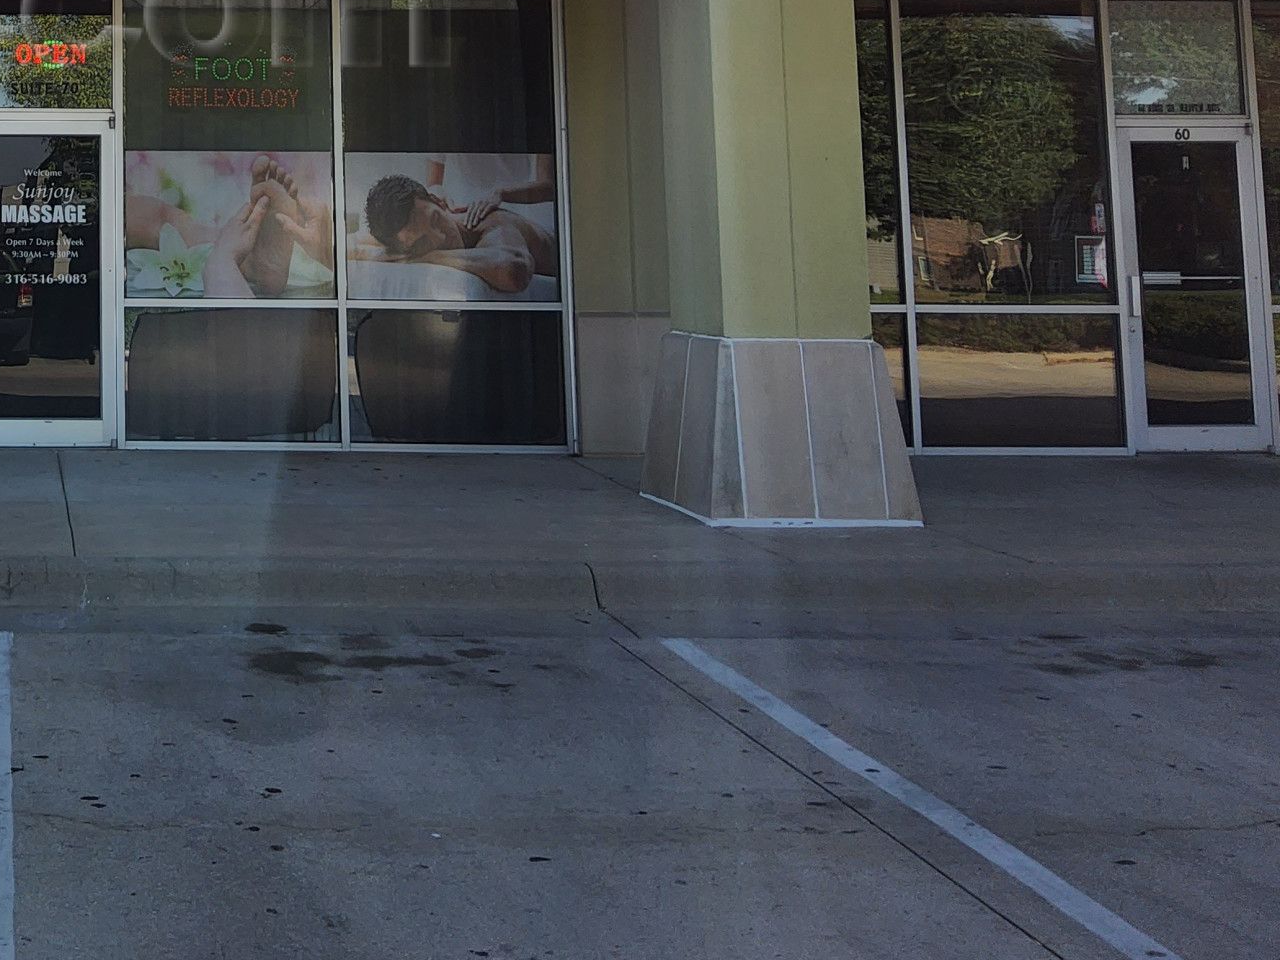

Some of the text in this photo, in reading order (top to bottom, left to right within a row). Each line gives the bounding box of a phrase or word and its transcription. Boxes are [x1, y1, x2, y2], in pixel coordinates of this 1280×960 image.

[15, 43, 87, 65] OPEN
[194, 57, 272, 81] FOOT
[10, 81, 55, 96] SUITE
[168, 87, 299, 108] REFLEXOLOGY
[1174, 128, 1190, 141] 60
[23, 168, 63, 177] Welcome
[12, 182, 75, 204] Sunjoy
[1, 204, 87, 224] MASSAGE
[5, 238, 27, 248] Open
[29, 238, 34, 246] 7
[36, 238, 54, 248] Days
[62, 238, 84, 246] Week
[11, 250, 42, 258] 9:30AM
[5, 273, 88, 285] 316-516-9083
